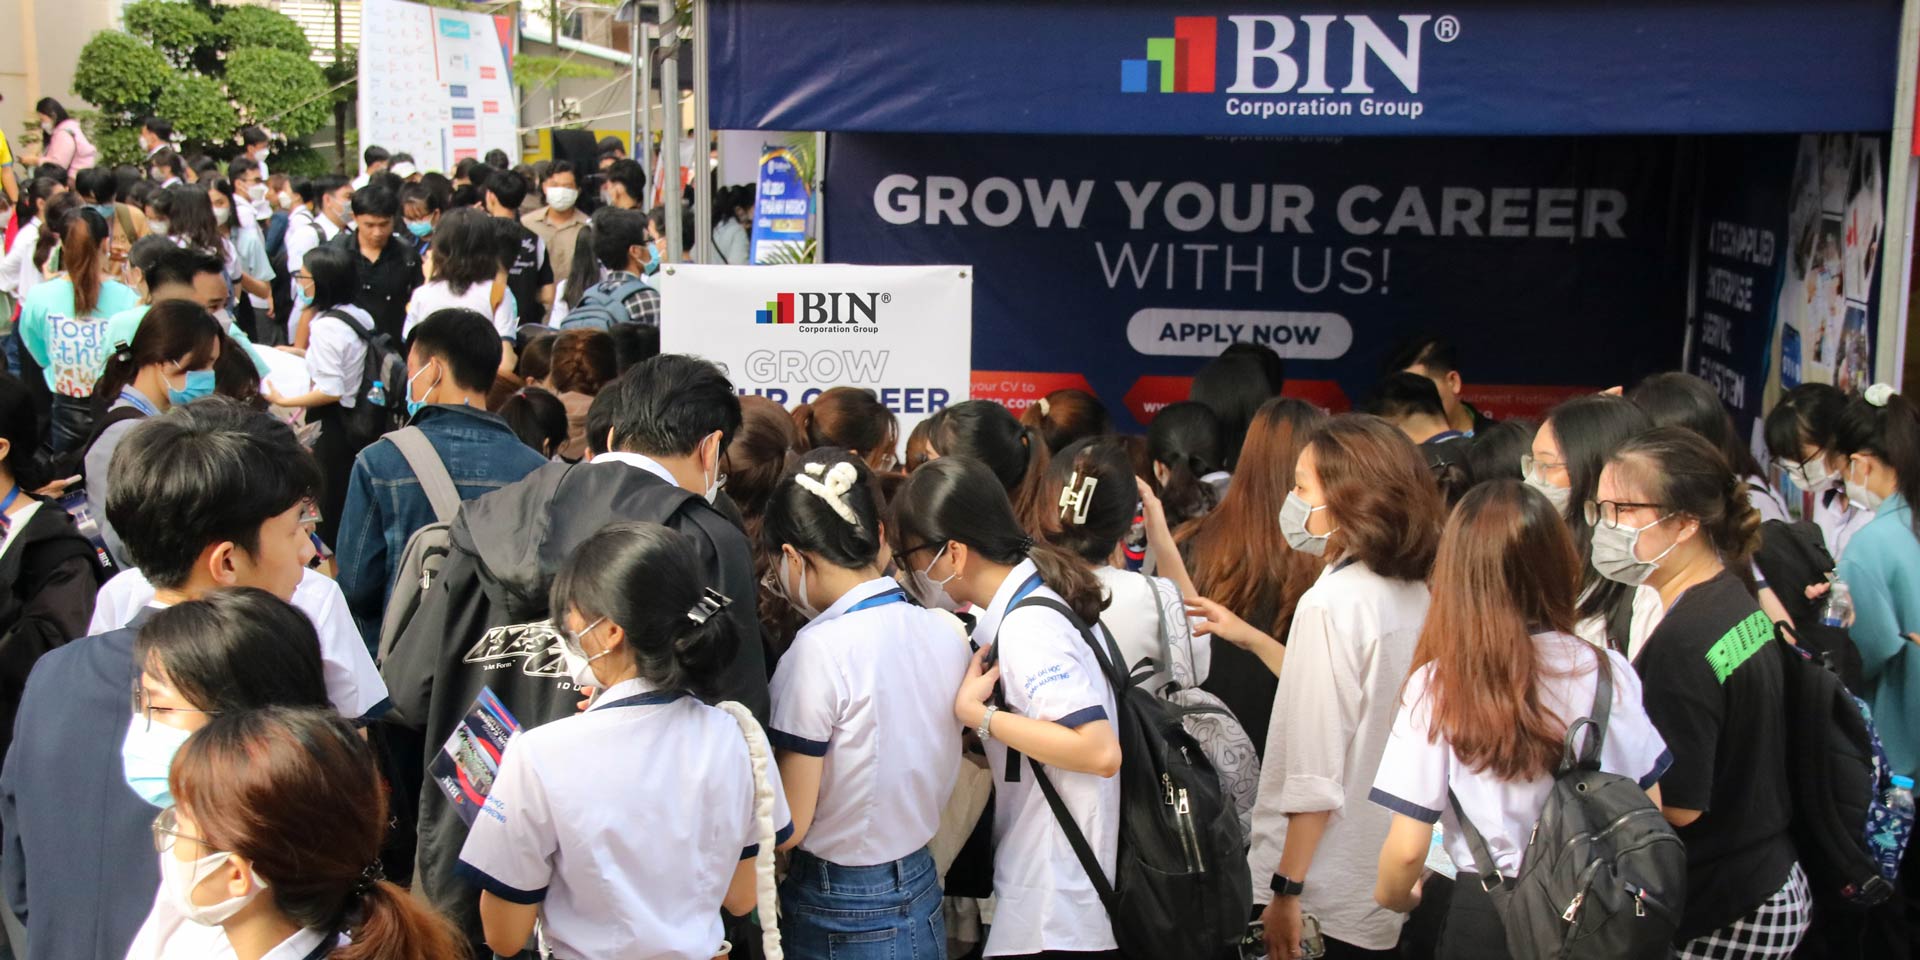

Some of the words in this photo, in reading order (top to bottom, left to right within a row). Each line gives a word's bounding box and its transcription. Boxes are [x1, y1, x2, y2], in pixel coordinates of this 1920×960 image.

[1226, 98, 1352, 119] Corporation
[1360, 98, 1424, 120] Group
[873, 174, 1095, 229] GROW
[1115, 180, 1315, 234] YOUR
[1336, 185, 1628, 239] CAREER
[1095, 241, 1264, 292] WITH
[1292, 246, 1391, 296] US!
[799, 325, 850, 334] Corporation
[853, 325, 879, 334] Group
[1159, 322, 1244, 344] APPLY
[1253, 325, 1321, 345] NOW
[745, 350, 890, 383] GROW
[1000, 381, 1019, 392] CV
[1022, 383, 1036, 393] to
